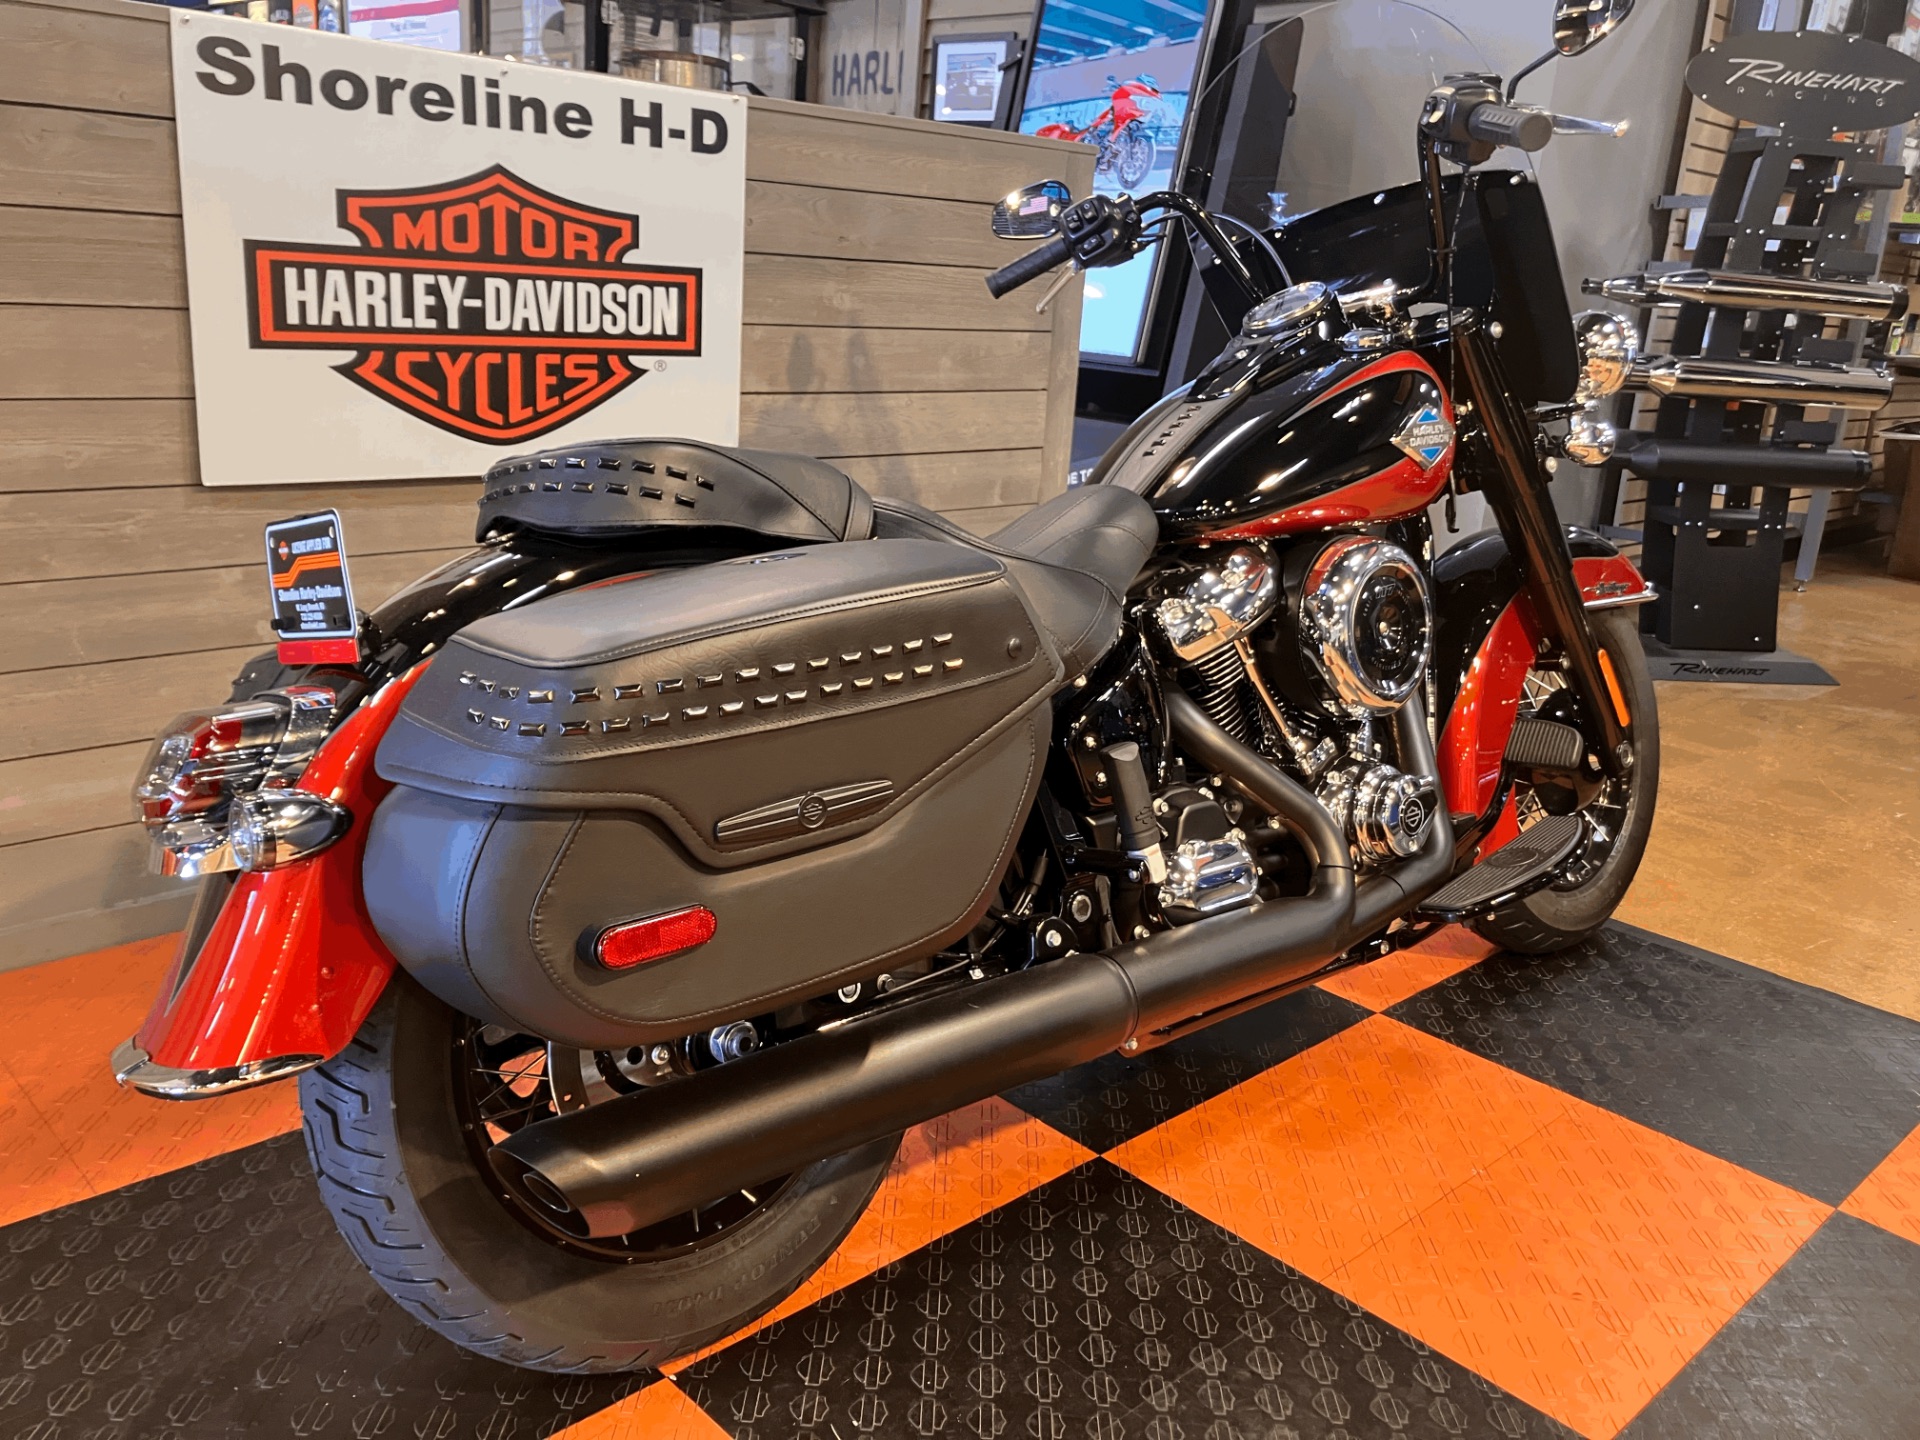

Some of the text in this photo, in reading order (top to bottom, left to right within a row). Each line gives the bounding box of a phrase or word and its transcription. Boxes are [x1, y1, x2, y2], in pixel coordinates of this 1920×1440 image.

[195, 35, 728, 155] Shoreline H-D
[1725, 57, 1904, 94] RINEHART
[1736, 86, 1885, 107] RACING
[393, 192, 602, 262] MOTOR
[284, 266, 679, 337] HARLEY-DAVIDSON
[394, 350, 600, 425] CYCLES
[1410, 434, 1449, 446] DAVIDSON
[1669, 662, 1771, 676] RINEHART
